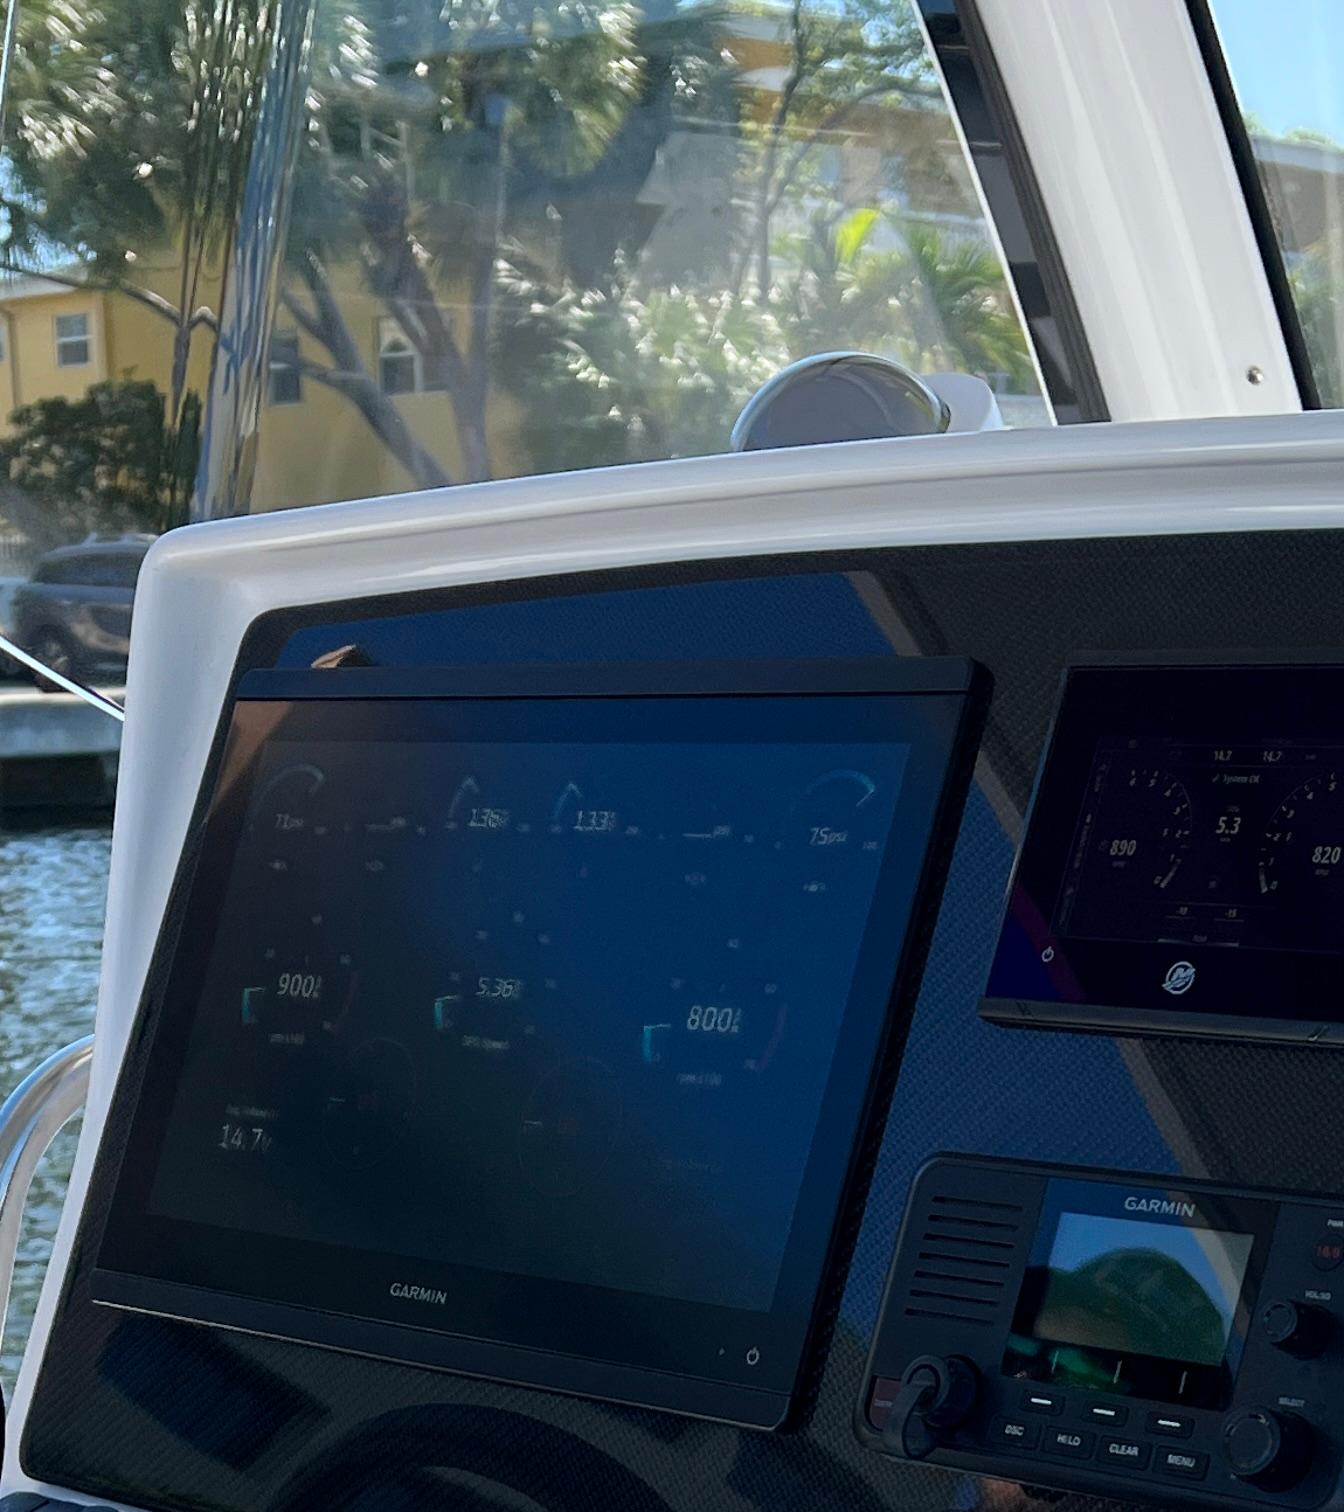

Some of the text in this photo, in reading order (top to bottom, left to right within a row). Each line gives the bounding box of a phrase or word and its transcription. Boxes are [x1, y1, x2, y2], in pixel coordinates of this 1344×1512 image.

[1215, 816, 1241, 835] 5.3
[1109, 839, 1137, 857] 890
[1311, 845, 1342, 864] 820
[1123, 1195, 1197, 1219] GARMIN
[388, 1281, 448, 1306] GARMIN
[1108, 1443, 1140, 1458] CLEAR
[1166, 1454, 1197, 1469] MENU
